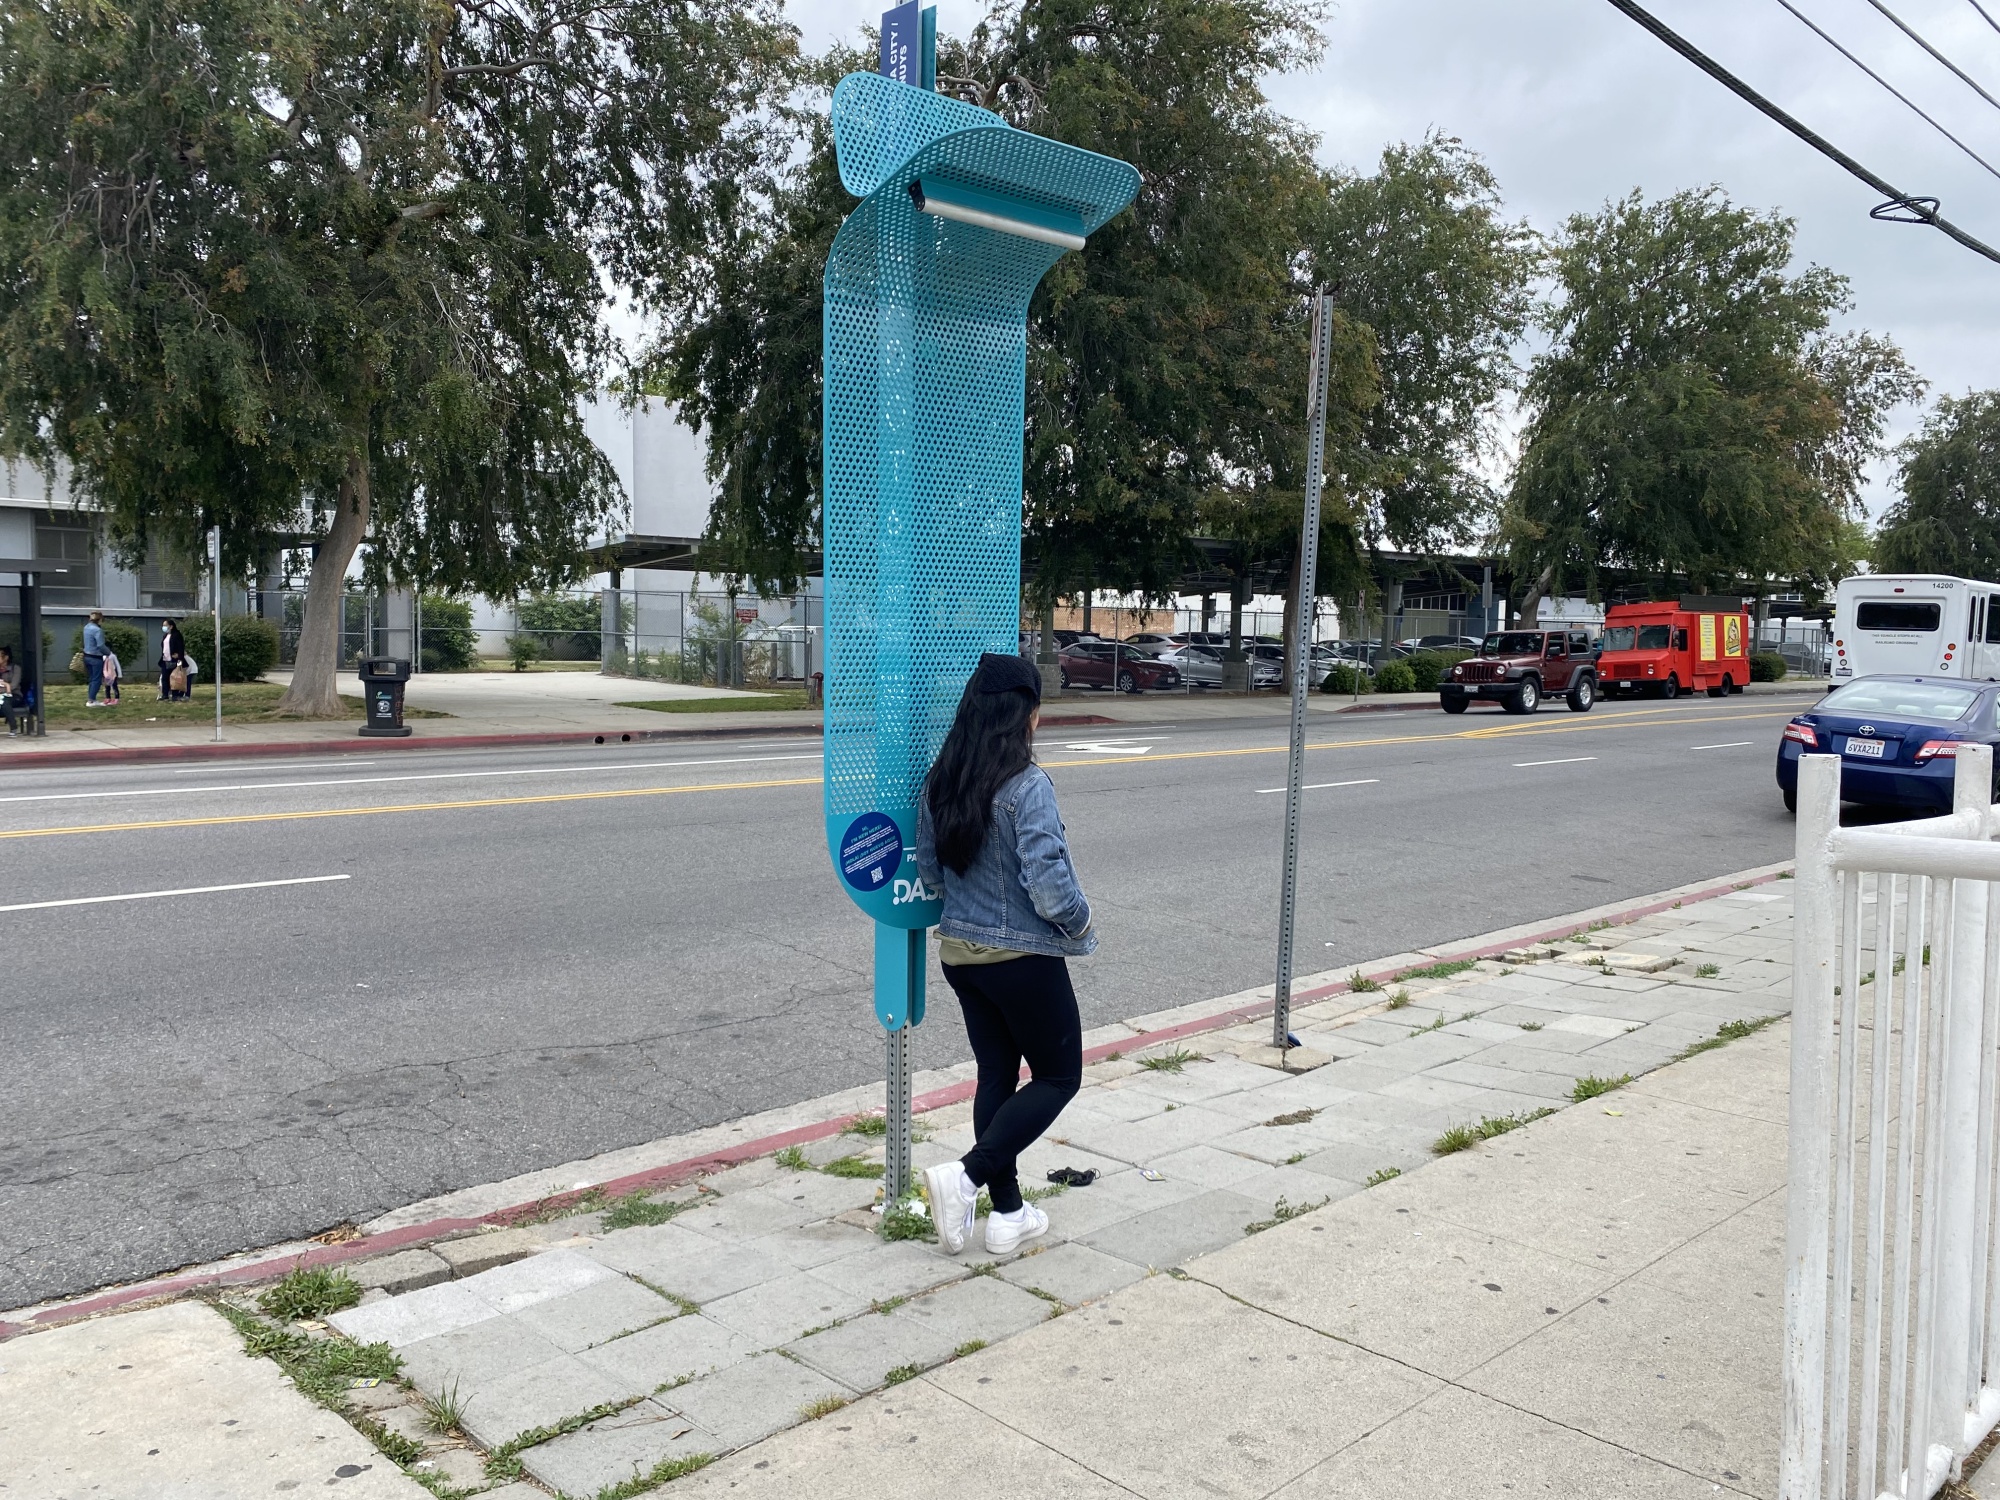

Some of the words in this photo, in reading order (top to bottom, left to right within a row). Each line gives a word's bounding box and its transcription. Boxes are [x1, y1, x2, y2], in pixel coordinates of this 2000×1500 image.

[890, 31, 898, 65] CITY
[1848, 743, 1880, 755] 6VXA211
[907, 854, 917, 862] PA
